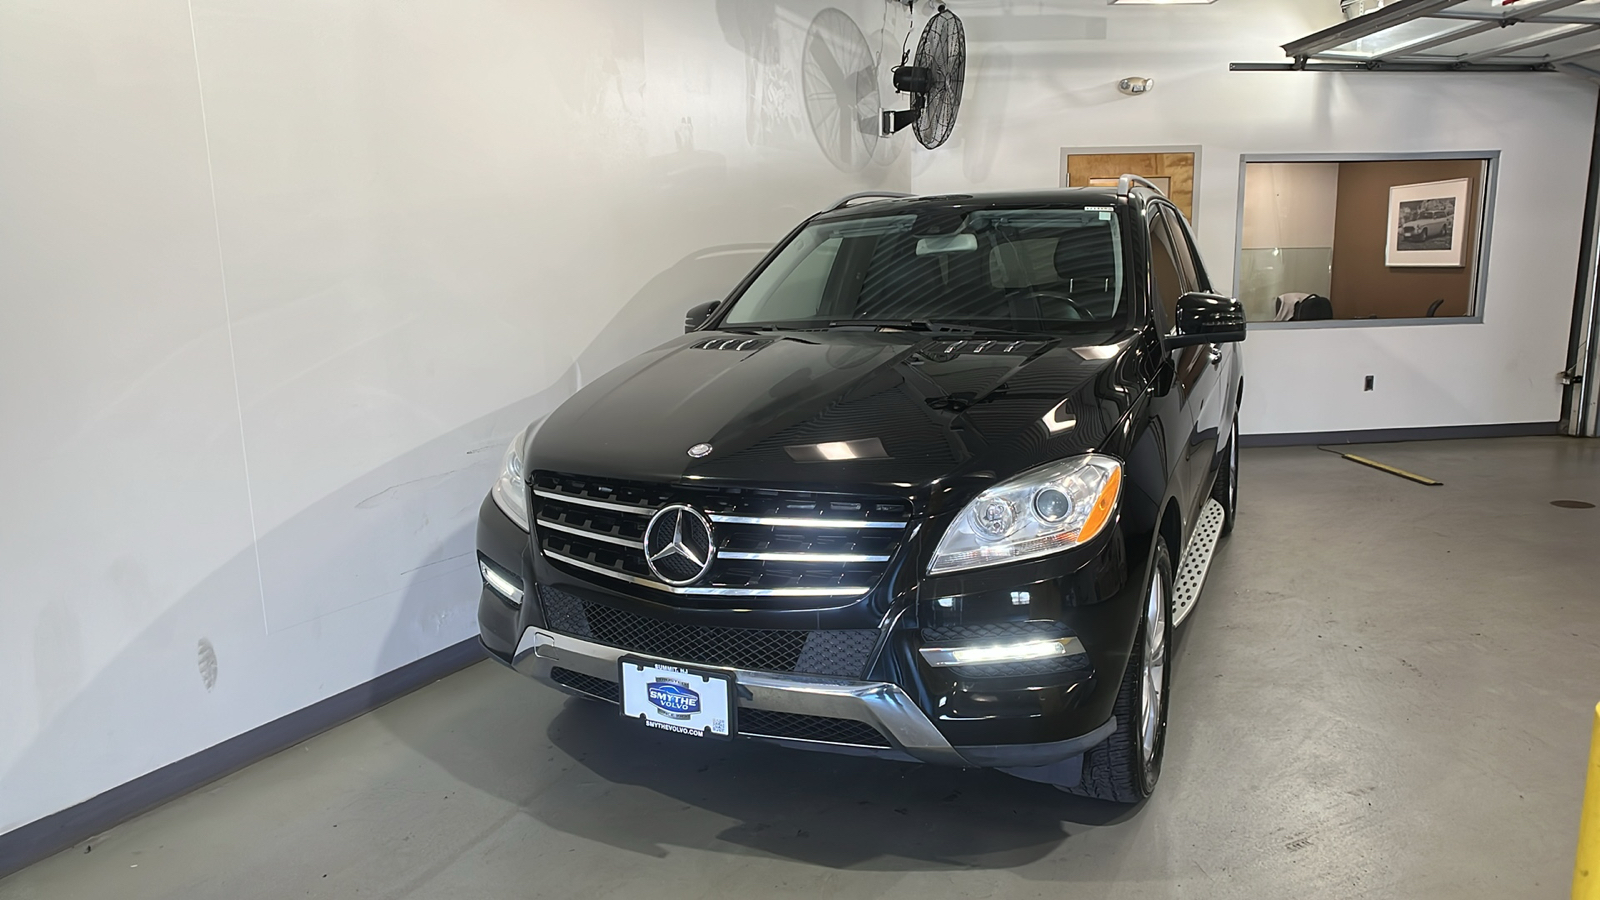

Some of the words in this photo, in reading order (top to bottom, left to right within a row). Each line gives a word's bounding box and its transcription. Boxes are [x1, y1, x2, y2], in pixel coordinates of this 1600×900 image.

[649, 690, 697, 707] SMYTHE
[660, 700, 689, 710] VOLVO
[645, 720, 704, 737] SMYTHEVOLVO.COM
